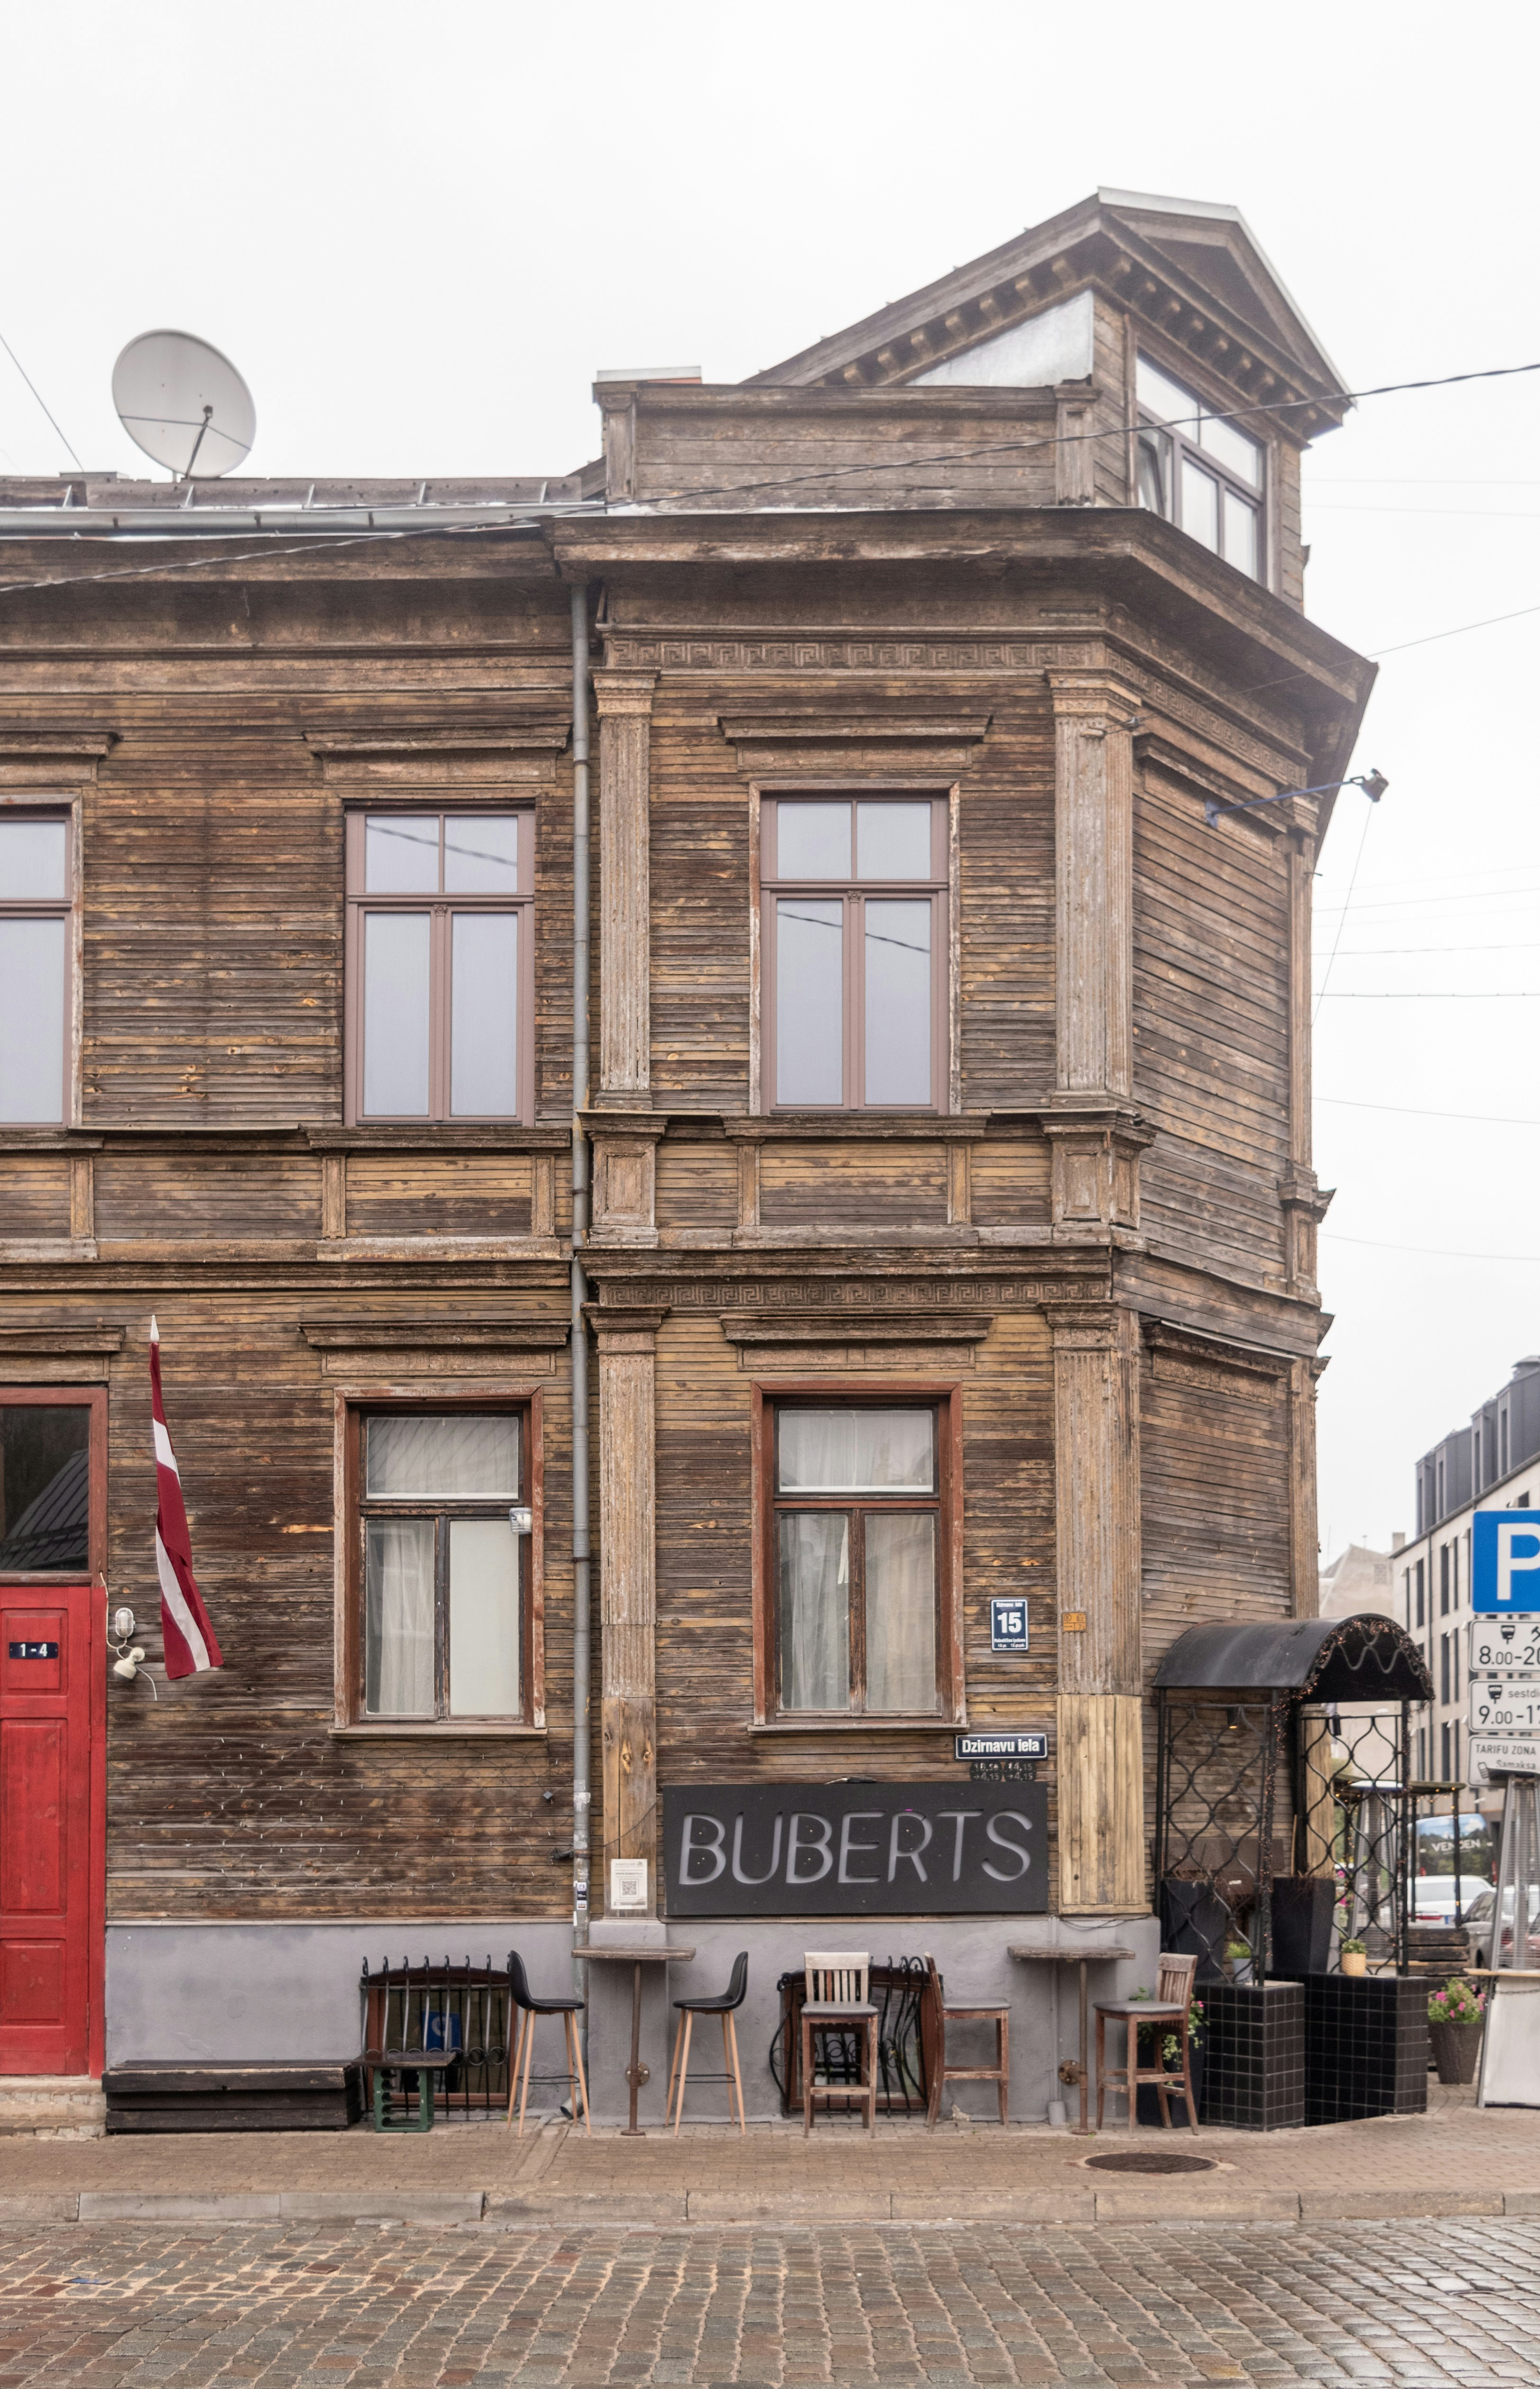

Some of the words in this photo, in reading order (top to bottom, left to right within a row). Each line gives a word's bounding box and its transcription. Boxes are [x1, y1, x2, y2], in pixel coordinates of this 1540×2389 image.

[1497, 1523, 1540, 1600] P
[998, 1612, 1022, 1633] 15
[1479, 1705, 1540, 1724] 9.00-1
[962, 1740, 1015, 1752] Dzirnavu
[1018, 1739, 1039, 1751] iela
[1476, 1744, 1508, 1754] TARIFU
[1512, 1746, 1536, 1755] ZONA
[1496, 1759, 1536, 1770] Samaksa
[679, 1809, 1033, 1885] BUBERTS
